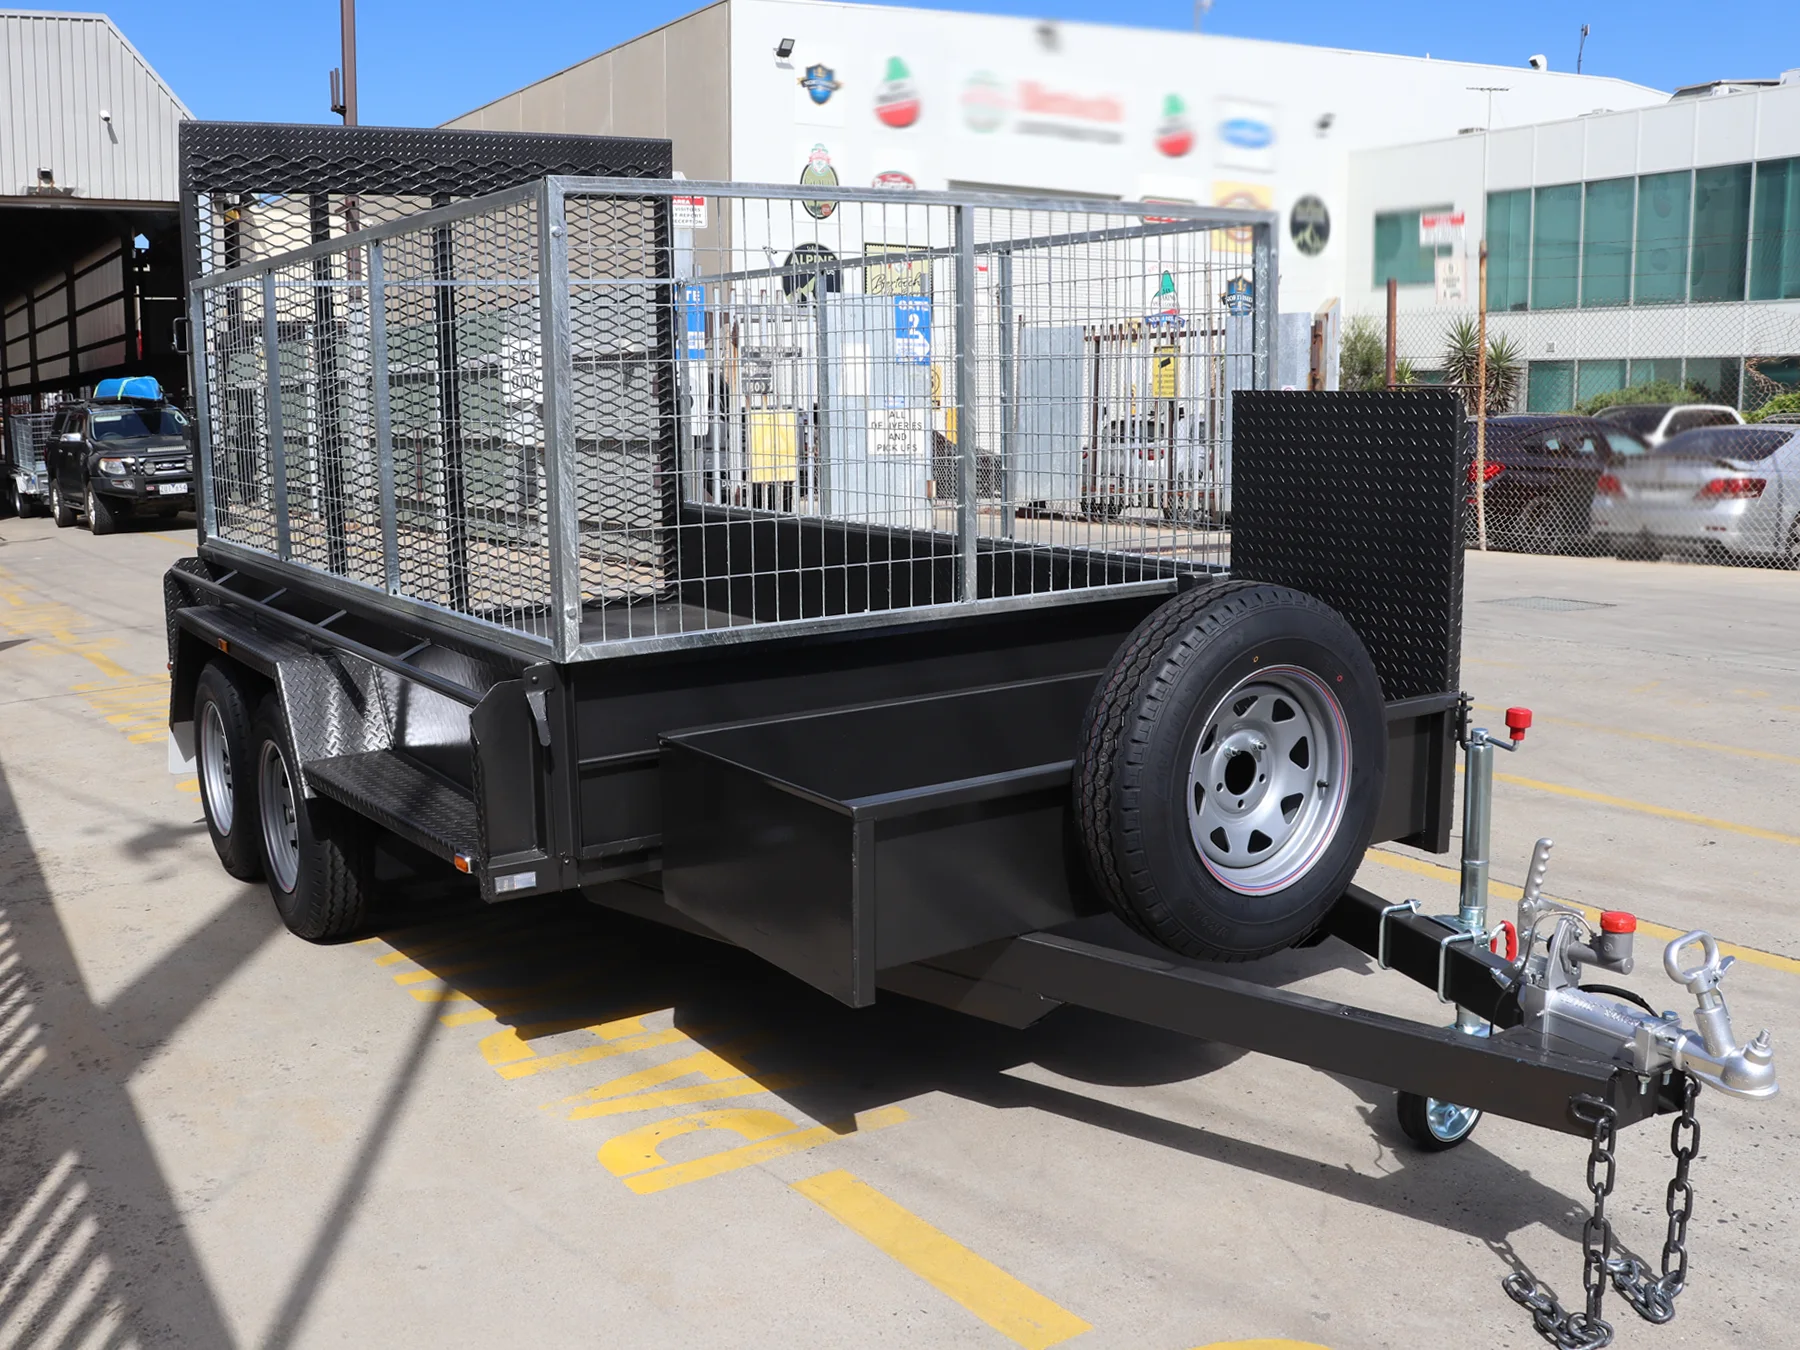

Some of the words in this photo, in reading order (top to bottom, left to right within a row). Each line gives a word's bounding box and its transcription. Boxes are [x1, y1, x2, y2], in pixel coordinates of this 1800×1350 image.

[790, 253, 834, 265] ALPINE
[888, 411, 906, 419] ALL
[871, 421, 923, 431] DEIVERES
[888, 433, 907, 441] AND
[876, 444, 898, 452] PICK
